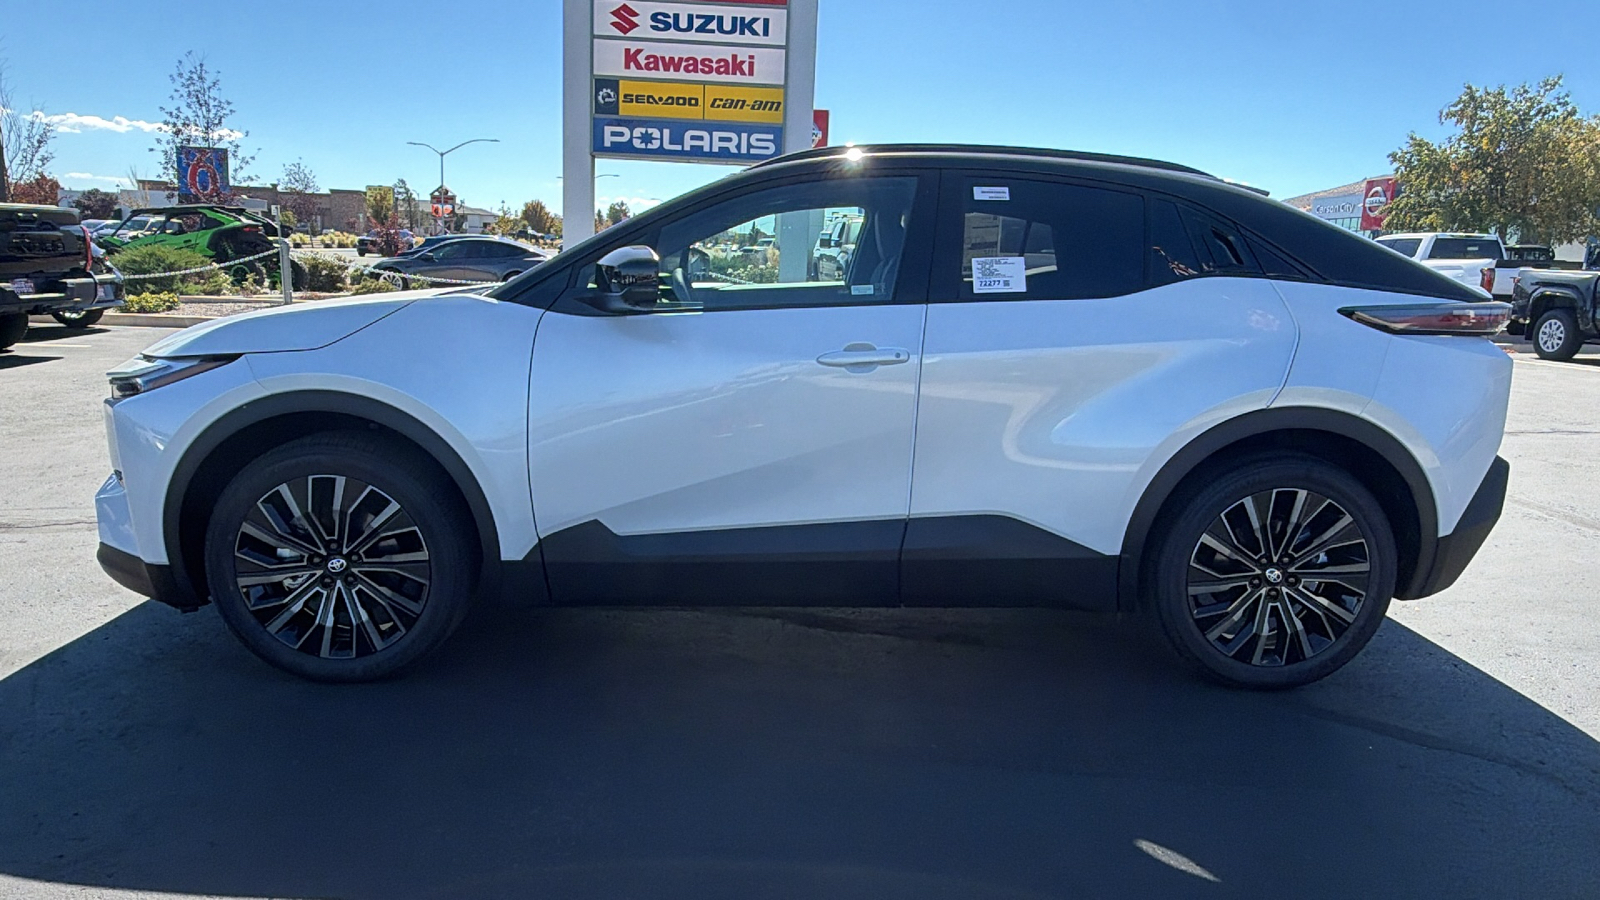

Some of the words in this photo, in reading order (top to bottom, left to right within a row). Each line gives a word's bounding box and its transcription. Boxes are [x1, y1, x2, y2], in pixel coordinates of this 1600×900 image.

[650, 12, 770, 37] SUZUKI
[624, 48, 755, 77] Kawasaki
[710, 97, 781, 112] can-am
[603, 125, 776, 155] POLARIS
[1315, 204, 1340, 214] Carson
[1340, 202, 1355, 213] City
[979, 279, 1001, 288] 72277
